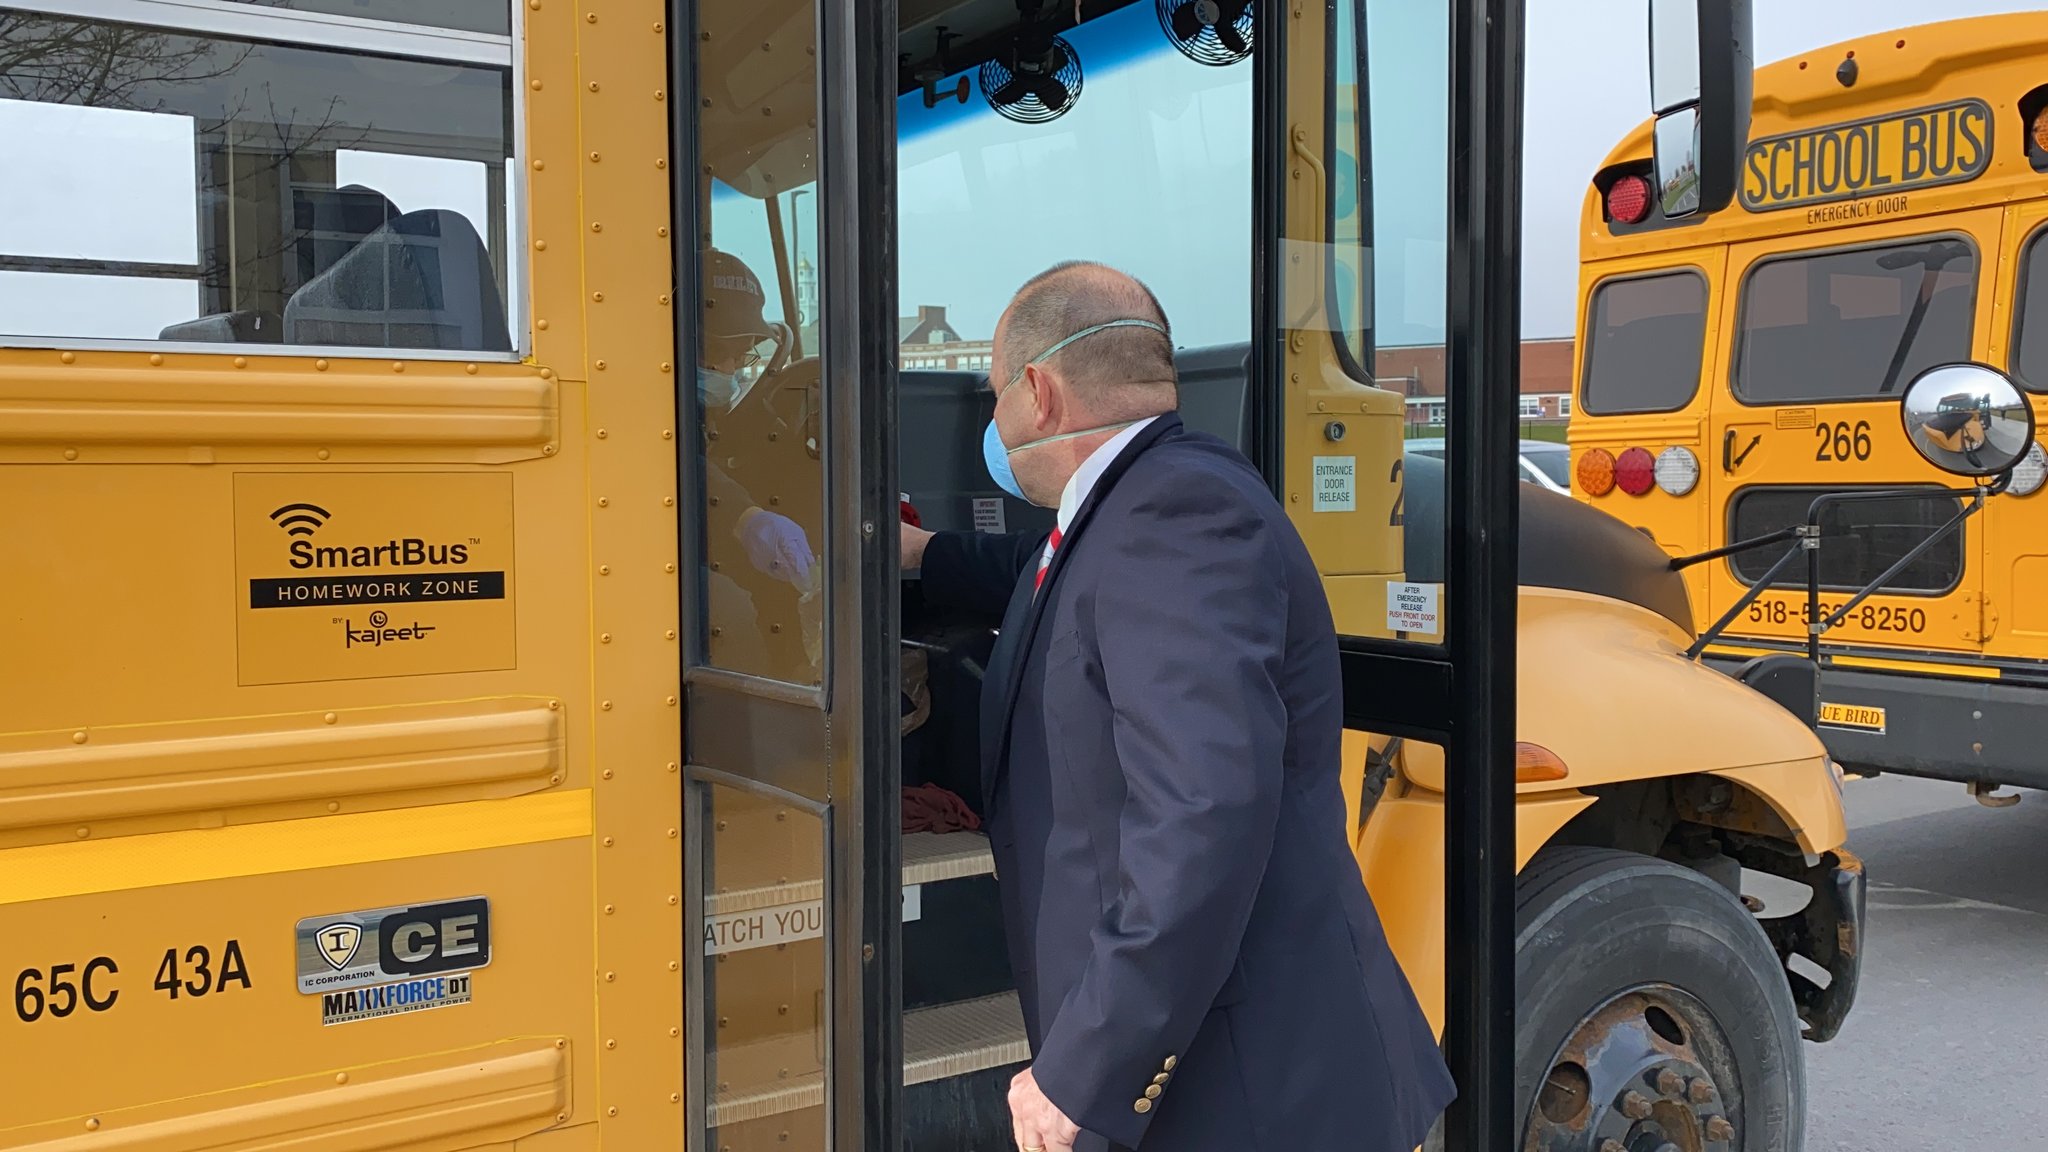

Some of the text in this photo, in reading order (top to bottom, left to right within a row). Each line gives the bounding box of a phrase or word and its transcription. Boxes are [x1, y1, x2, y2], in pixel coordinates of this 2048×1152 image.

[1746, 105, 1985, 204] SCHOOL BUS
[1807, 196, 1908, 224] EMERGENCY DOOR
[1816, 420, 1871, 462] 266
[1316, 465, 1353, 476] ENTRANCE
[1324, 479, 1345, 489] DOOR
[1389, 459, 1404, 526] 2
[1319, 492, 1350, 502] RELEASE
[289, 538, 468, 569] SmartBus
[278, 579, 480, 601] HOMEWORK ZONE
[1396, 594, 1427, 603] EMERGENCY
[1404, 586, 1421, 594] AFTER
[1388, 610, 1436, 621] PUSH FRONT DOOR
[1400, 602, 1423, 612] RELEASE
[345, 609, 436, 649] kajeet
[1401, 620, 1424, 629] TO OPEN
[1818, 706, 1880, 725] UE BIRD
[391, 914, 479, 963] CE
[14, 939, 253, 1024] 65C 43A
[316, 970, 375, 985] CORPORATION
[324, 976, 469, 1017] MAXXFORCE DT
[324, 996, 471, 1026] INTERNATIONAL DIESEL POWER
